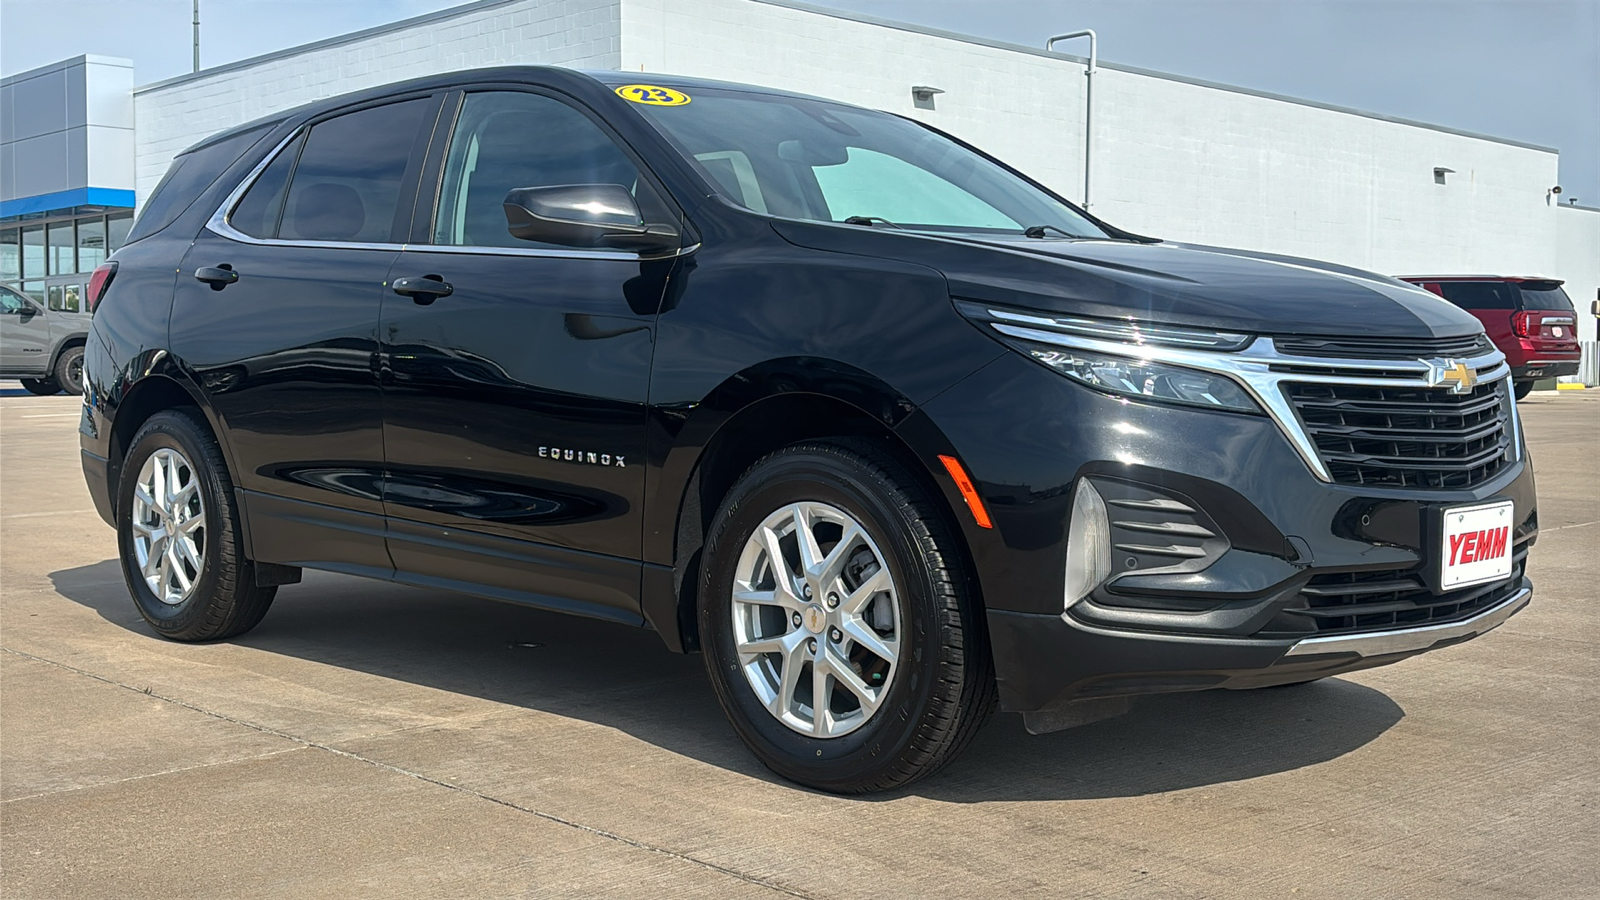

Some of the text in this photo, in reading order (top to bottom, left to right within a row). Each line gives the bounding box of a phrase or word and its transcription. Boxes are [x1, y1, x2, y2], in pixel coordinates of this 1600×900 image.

[632, 88, 673, 102] 23
[538, 446, 626, 468] EQUINOX
[1449, 526, 1509, 567] YEMM
